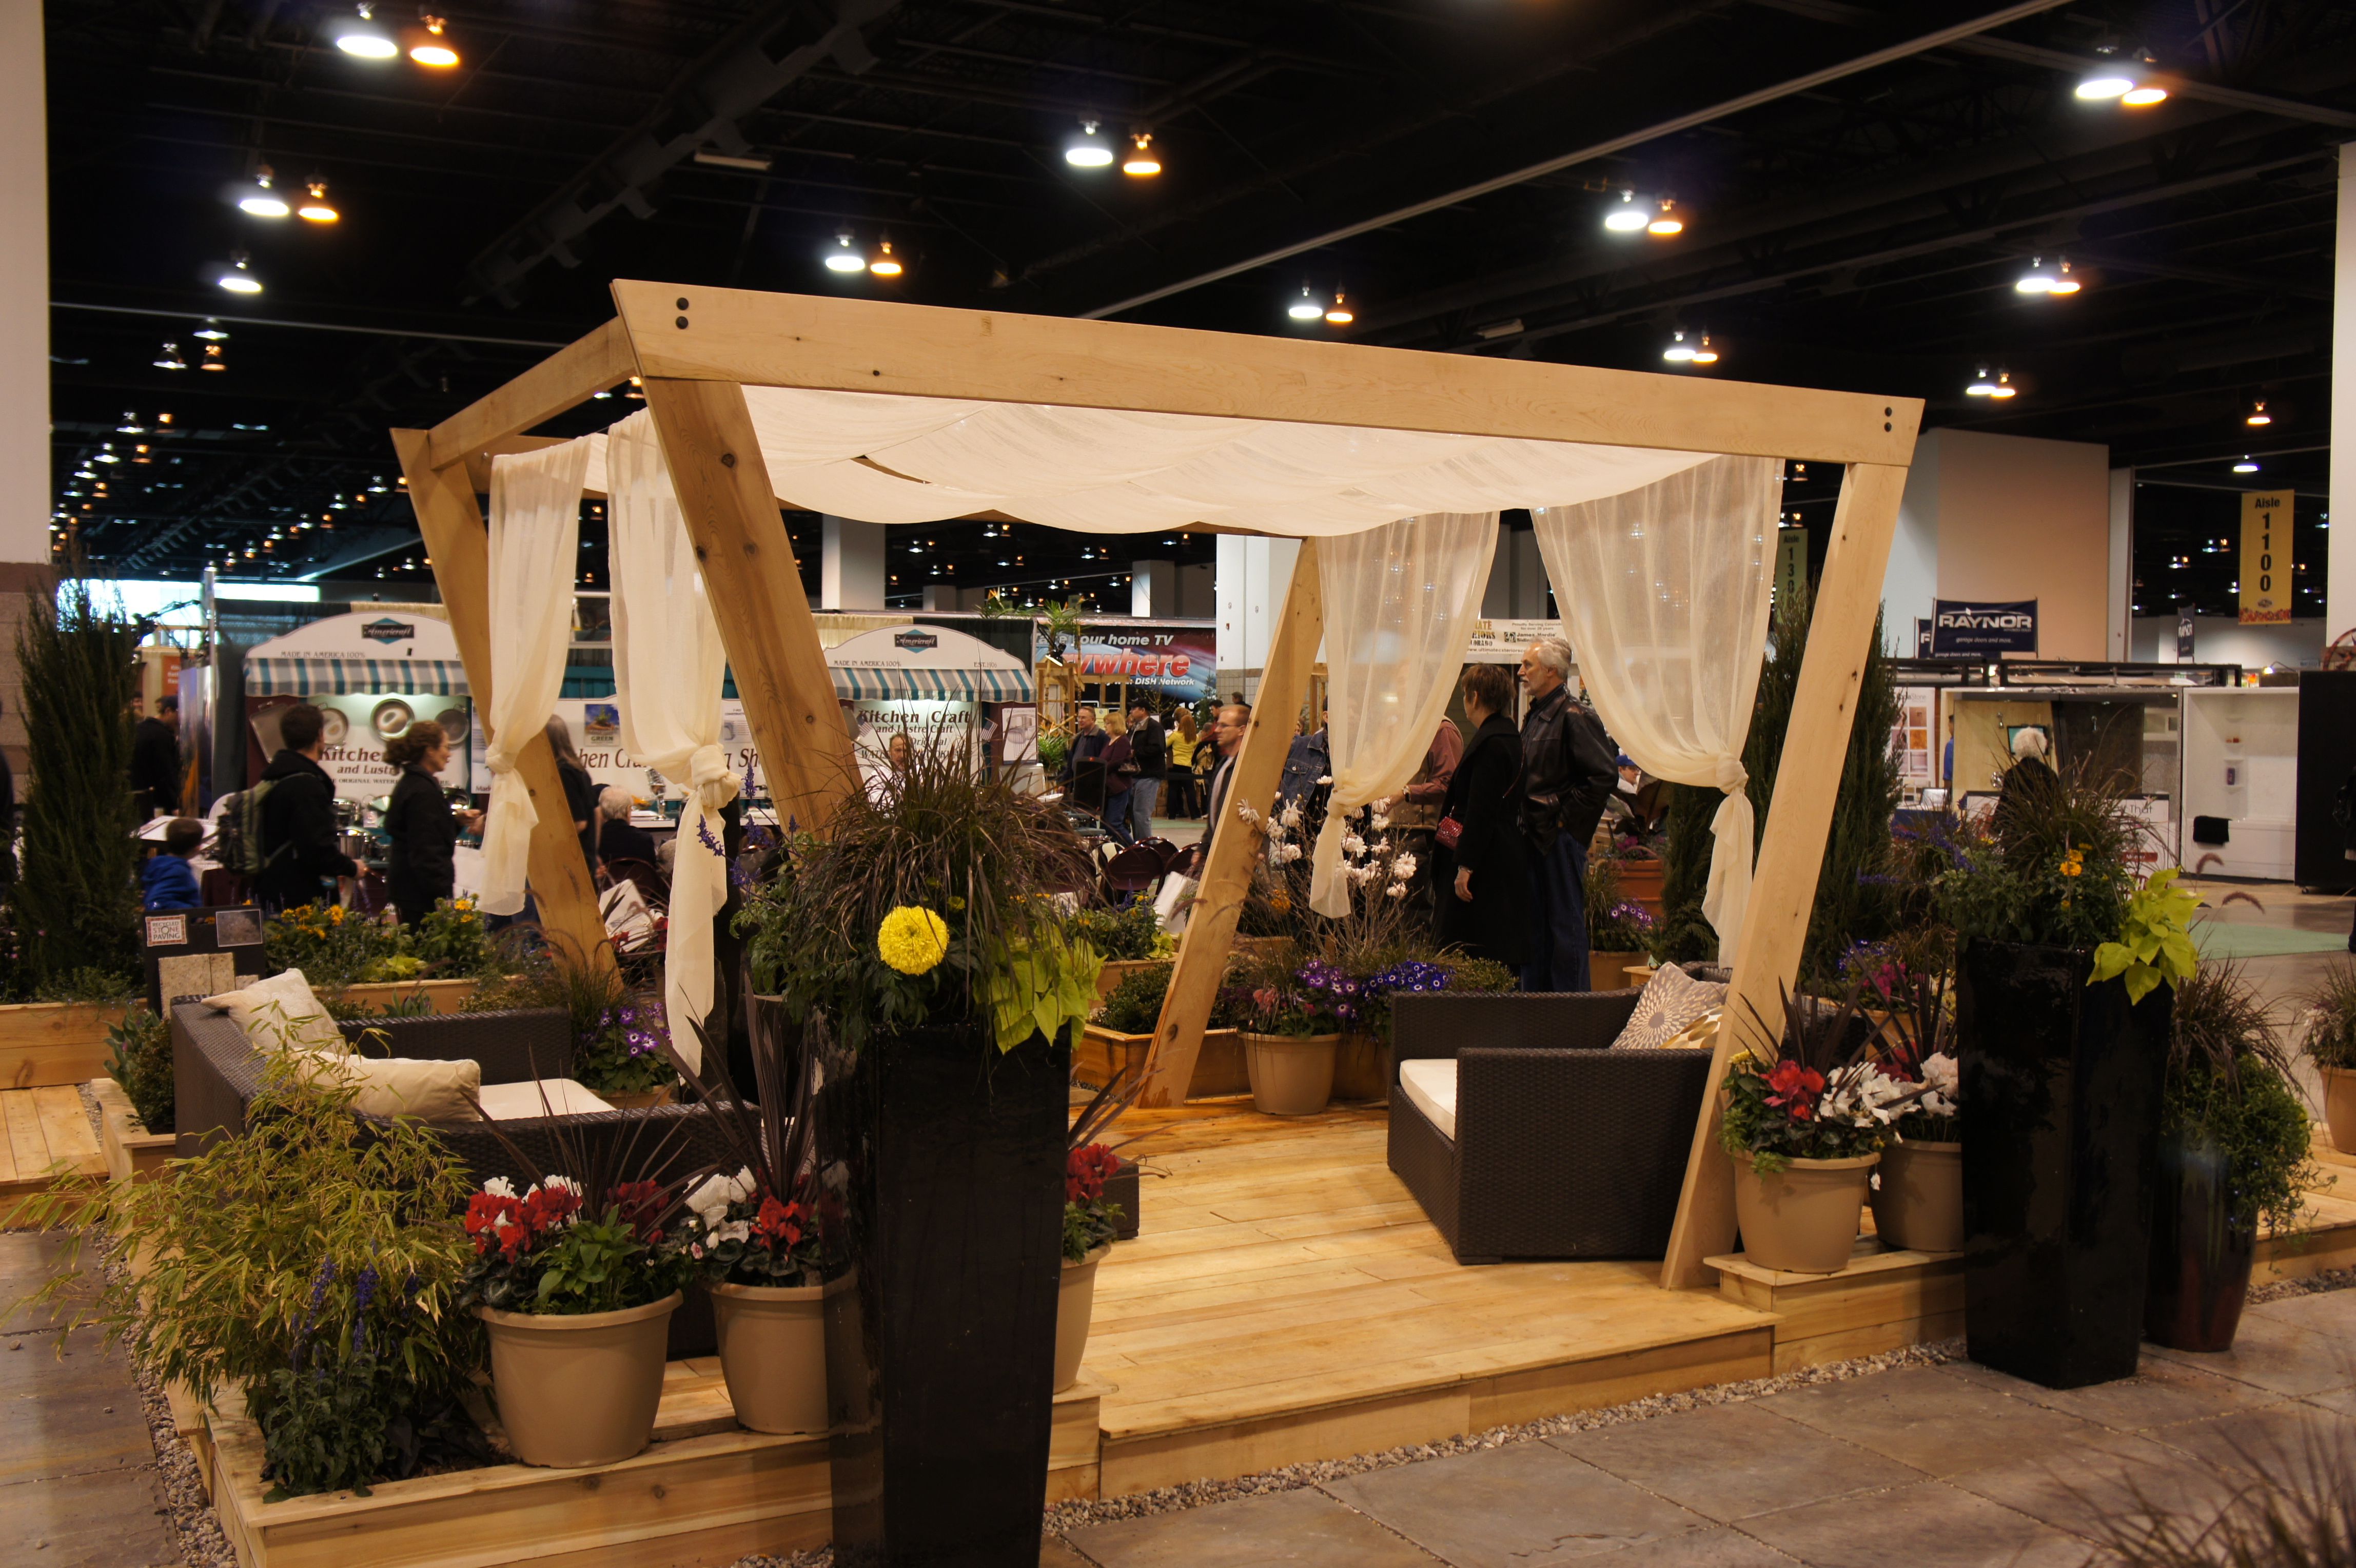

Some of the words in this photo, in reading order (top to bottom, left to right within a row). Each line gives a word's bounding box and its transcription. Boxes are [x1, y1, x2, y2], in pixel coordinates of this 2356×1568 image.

[2255, 497, 2281, 508] Aisle
[1784, 535, 1800, 543] Aisle
[1939, 615, 2032, 629] RAYNOR
[1070, 634, 1105, 647] our
[1108, 634, 1150, 646] home
[1154, 635, 1174, 646] TV
[931, 710, 970, 723] Craft
[877, 724, 894, 733] and
[897, 724, 927, 733] Lstre
[930, 724, 953, 733] Caft
[319, 747, 385, 762] Kitche
[337, 765, 359, 774] and
[2131, 805, 2153, 814] That
[153, 926, 180, 935] STONE
